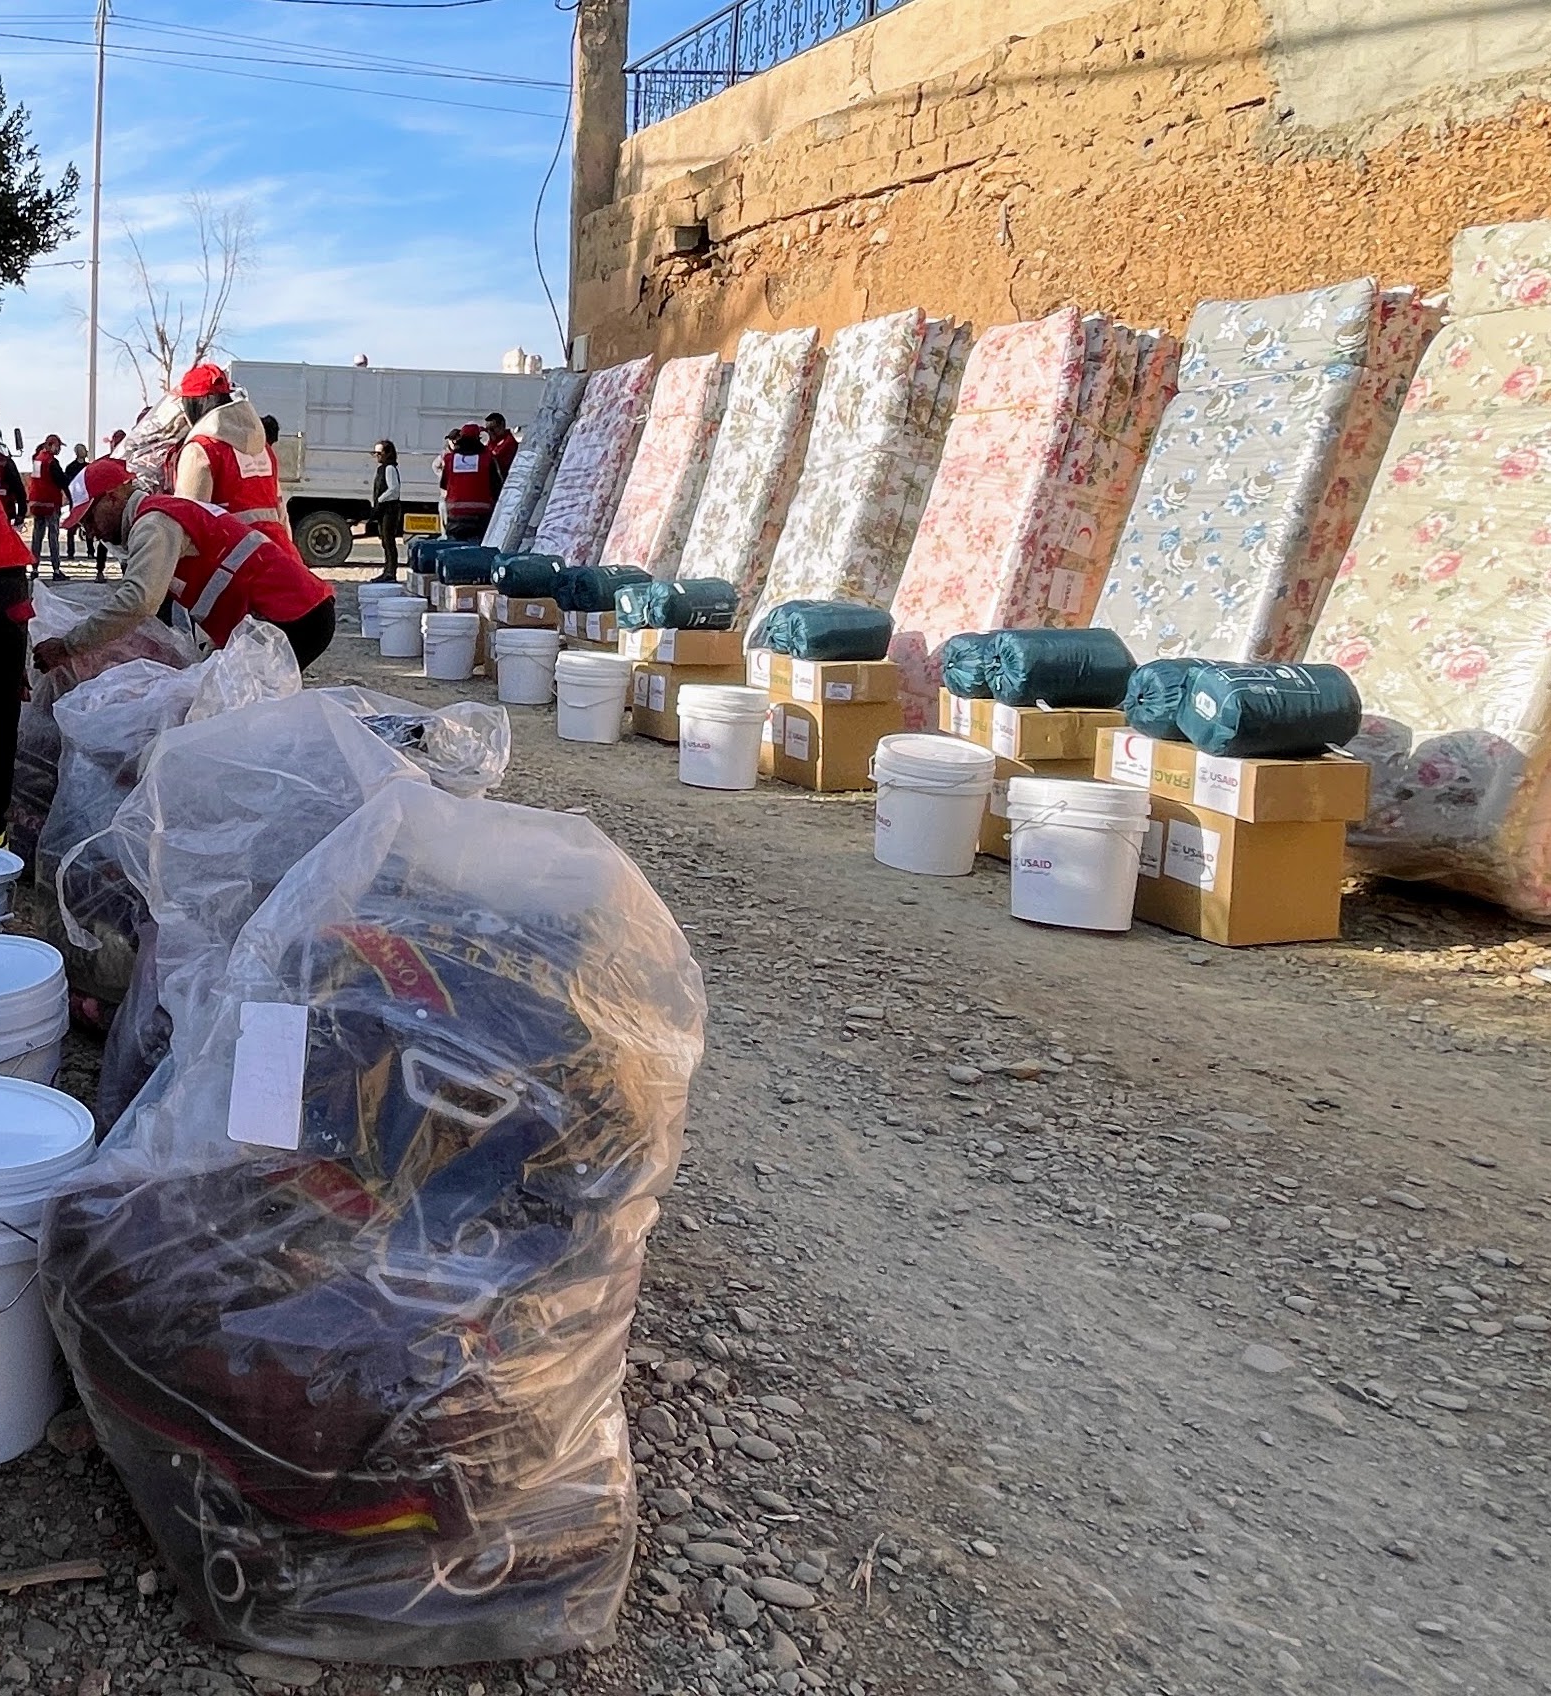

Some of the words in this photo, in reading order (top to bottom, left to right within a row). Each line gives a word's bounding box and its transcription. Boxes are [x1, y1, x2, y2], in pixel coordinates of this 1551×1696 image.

[1154, 770, 1191, 789] FRAG
[1209, 772, 1238, 787] USAID
[1021, 859, 1052, 869] USAID
